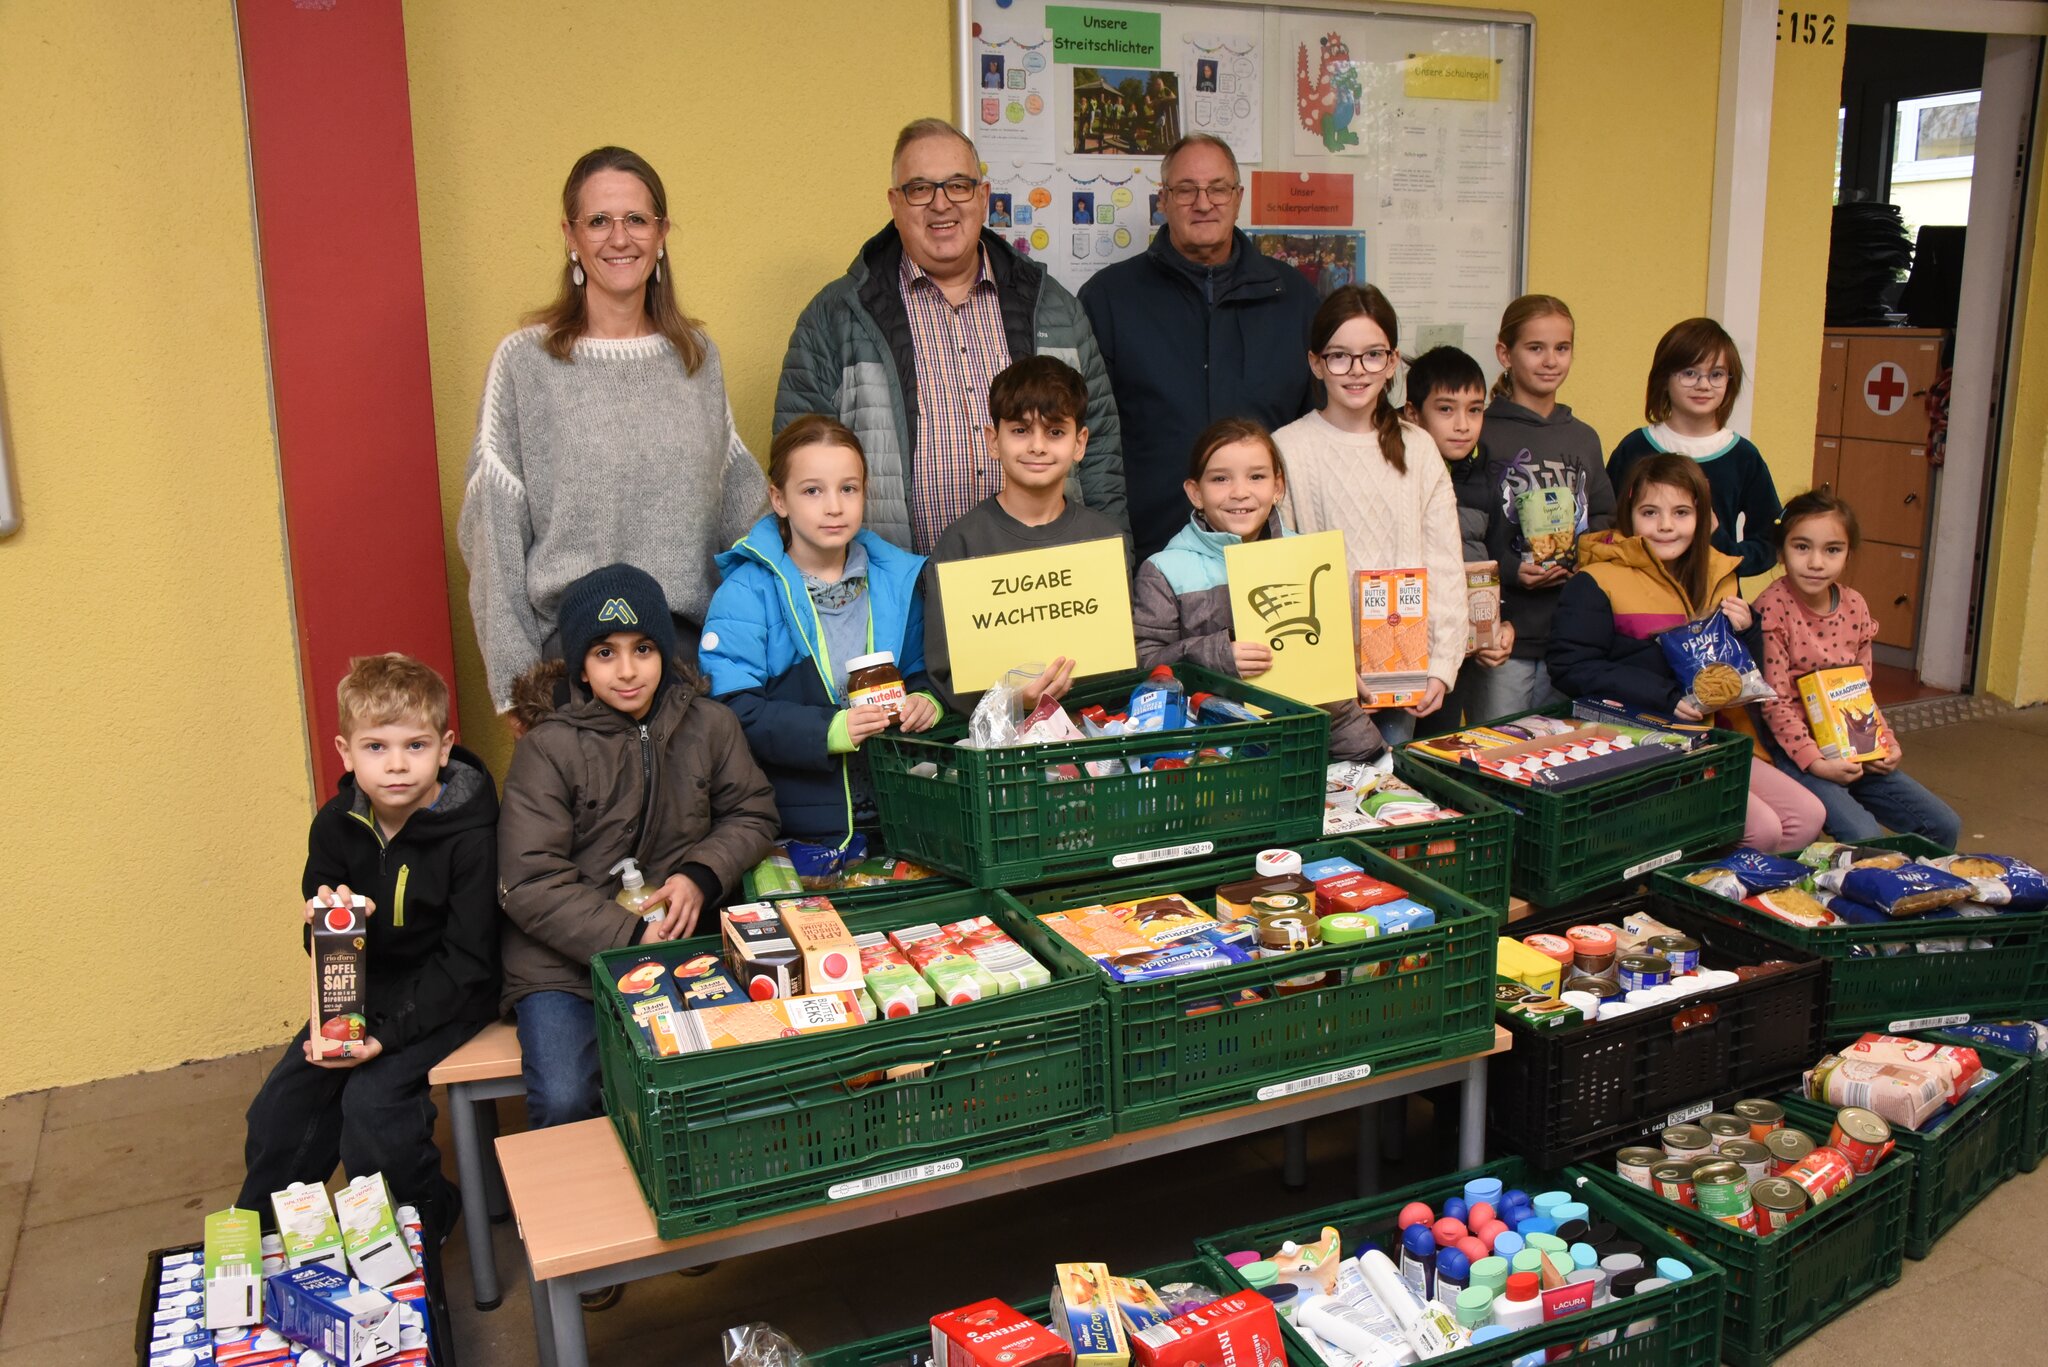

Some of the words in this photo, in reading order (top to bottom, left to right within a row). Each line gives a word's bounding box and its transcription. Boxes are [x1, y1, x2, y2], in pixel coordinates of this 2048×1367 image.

[1083, 15, 1128, 30] Unsere
[1054, 37, 1155, 55] Streitschlichter
[1415, 67, 1443, 77] Unsere
[1444, 68, 1489, 82] Schulregeln
[1290, 187, 1316, 197] Unser
[1266, 203, 1339, 215] Schülerparlament
[991, 568, 1073, 597] ZUGABE
[1364, 589, 1386, 597] BUTTER
[1399, 587, 1421, 595] BUTTER
[1364, 597, 1386, 608] KEKS
[1399, 594, 1421, 606] KEKS
[971, 597, 1099, 630] WACHTBERG
[1475, 608, 1492, 621] REIS
[1681, 632, 1720, 653] PENNE
[866, 689, 903, 705] nutella
[1829, 680, 1868, 699] KAKAODRINK
[1200, 843, 1213, 852] 216
[805, 931, 841, 941] APFEL
[1140, 945, 1218, 972] Alpenmilch
[324, 963, 357, 975] APFEL
[323, 975, 357, 991] SAFT
[641, 1002, 665, 1013] APFEL
[802, 999, 824, 1024] KEKS
[817, 997, 835, 1023] BUTTER
[1356, 1066, 1369, 1075] 216
[1687, 1104, 1704, 1115] IFCO
[1651, 1122, 1666, 1132] 6420
[936, 1160, 961, 1174] 24603
[303, 1276, 343, 1291] Milch
[1552, 1297, 1586, 1311] LACURA
[1090, 1312, 1104, 1333] Grey
[972, 1320, 1033, 1343] INTENSO
[1080, 1323, 1092, 1348] Meßmer
[1095, 1333, 1109, 1351] Earl
